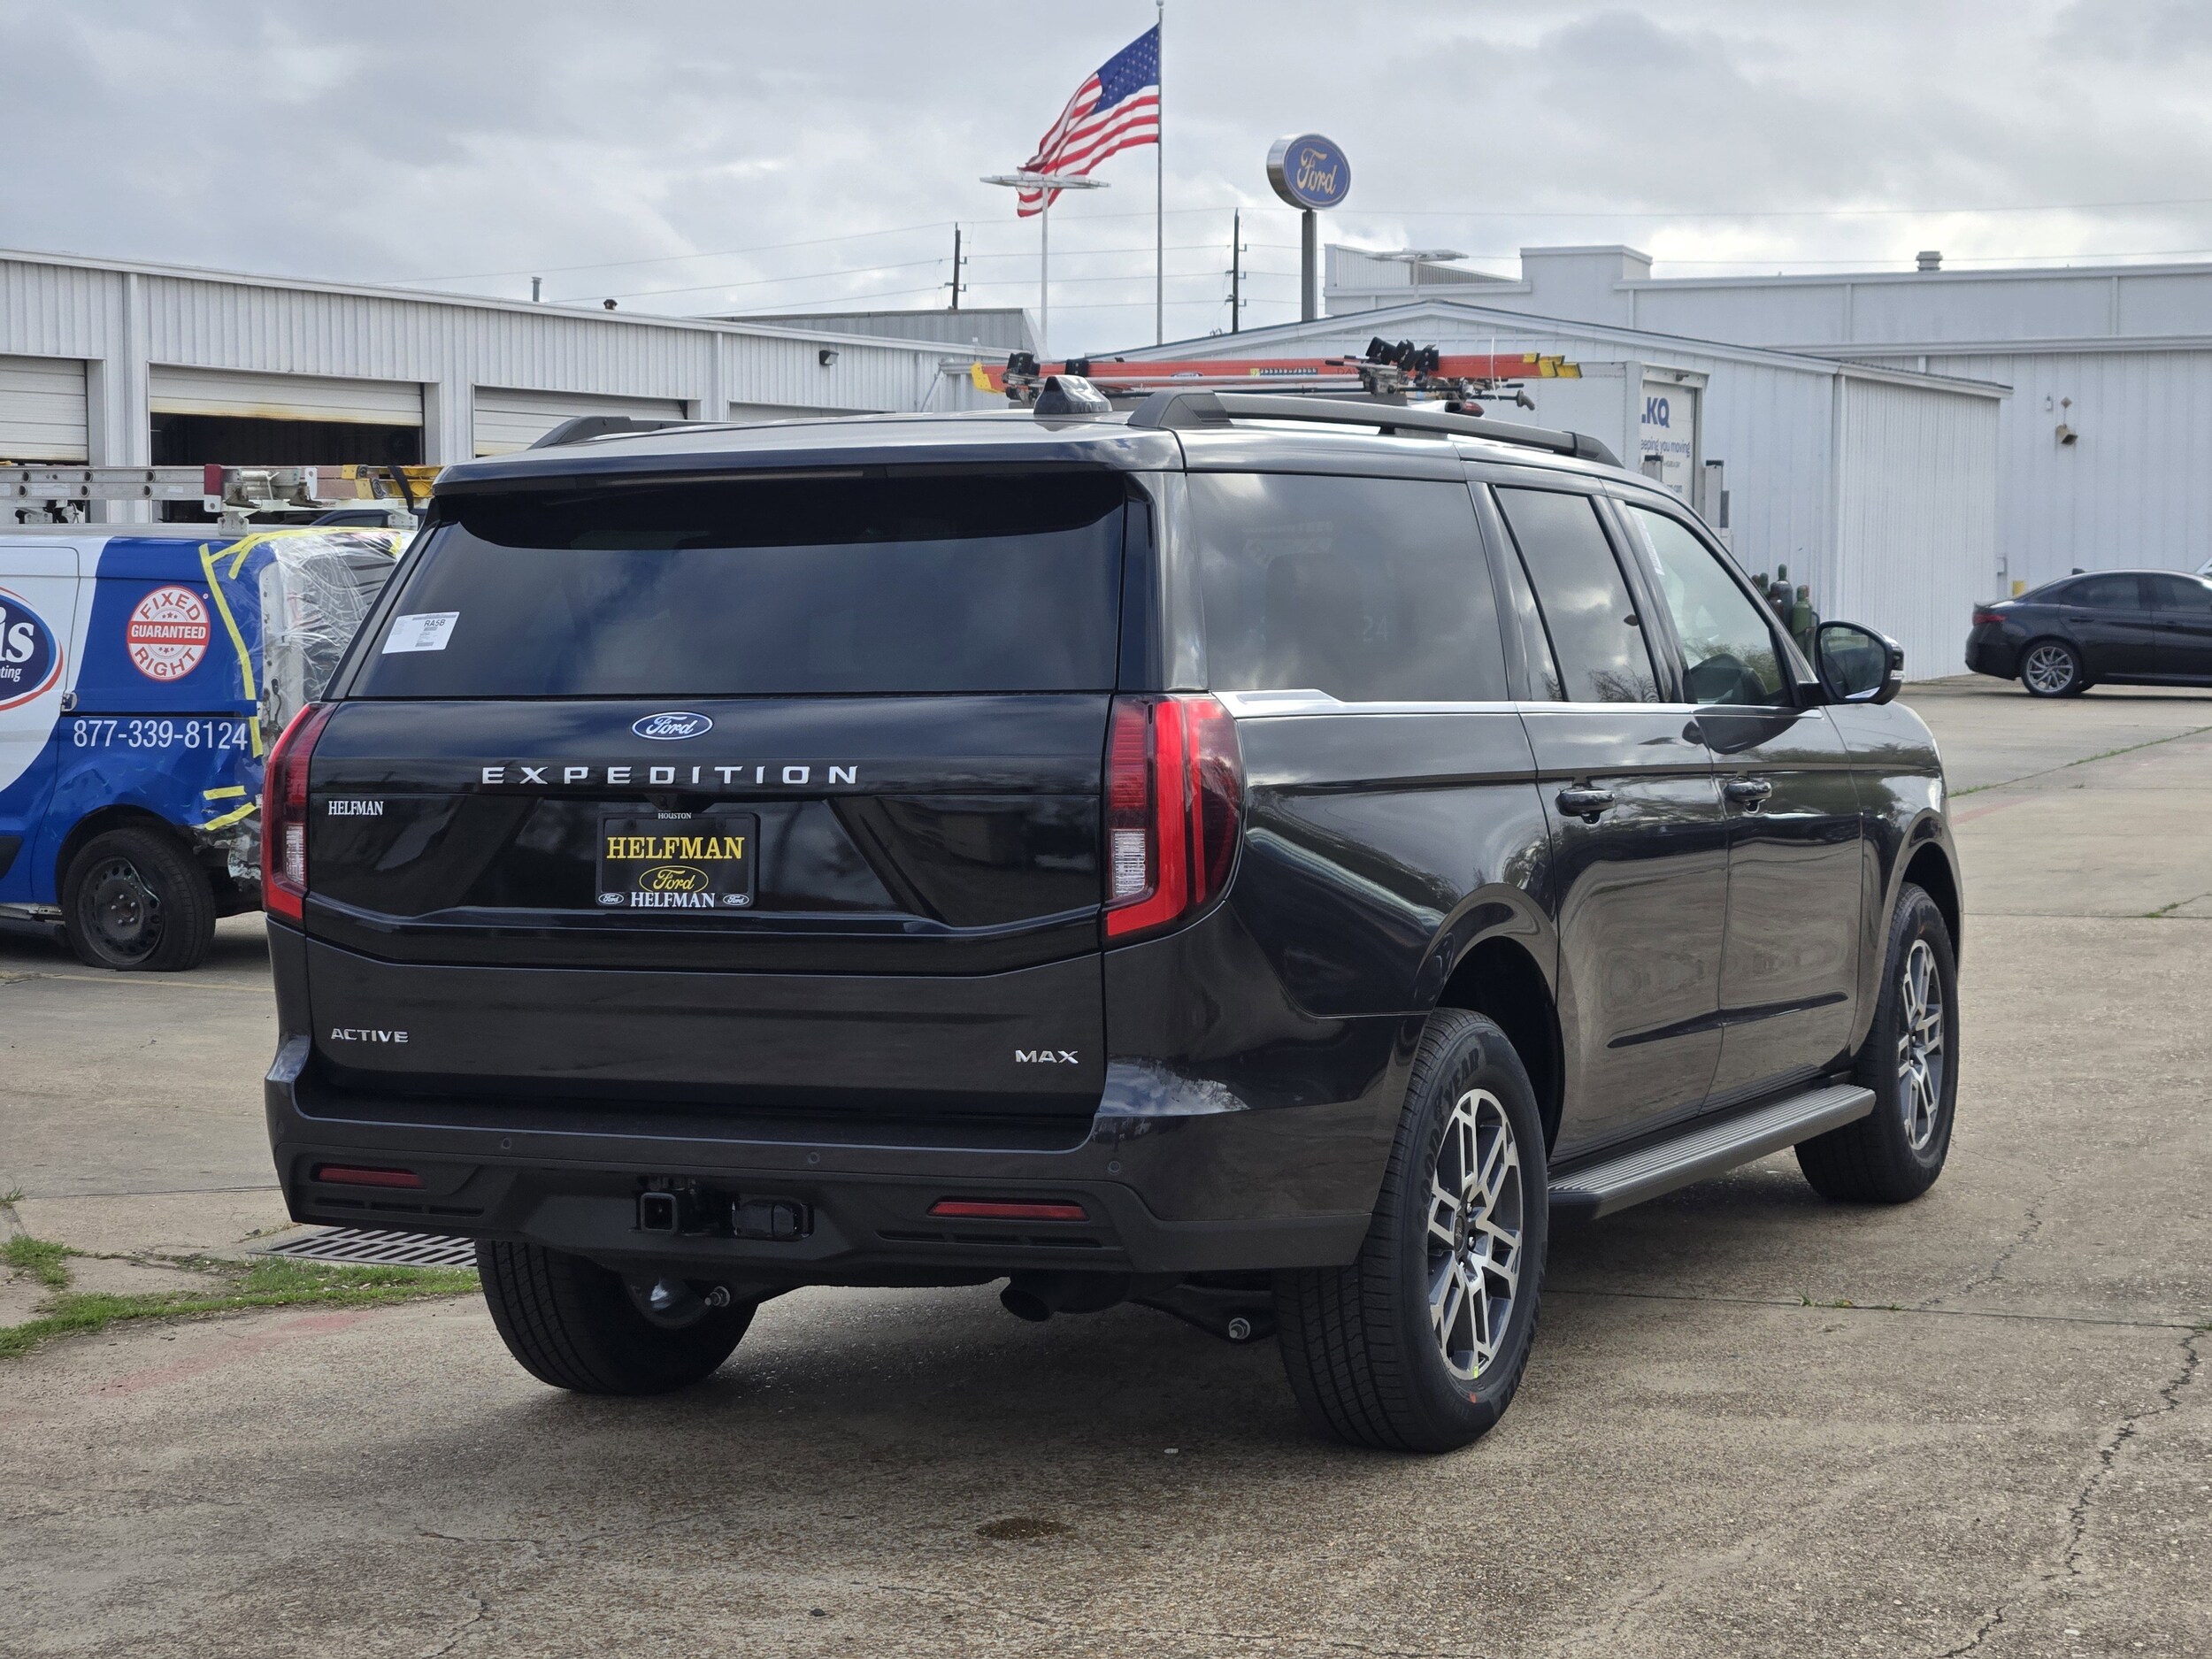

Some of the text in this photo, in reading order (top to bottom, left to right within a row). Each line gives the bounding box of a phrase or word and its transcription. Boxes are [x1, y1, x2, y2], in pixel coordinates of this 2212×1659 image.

[1297, 147, 1338, 195] Ford
[1641, 396, 1671, 428] KQ
[140, 592, 201, 621] FIXED
[131, 624, 207, 640] GUARANTEED
[134, 646, 196, 677] RIGHT
[0, 664, 22, 682] ting
[73, 719, 248, 751] 877-339-8124
[645, 716, 699, 735] Ford
[481, 765, 858, 785] EXPEDITION
[328, 800, 384, 816] HELFMAN
[606, 836, 745, 859] HELFMAN
[652, 869, 696, 890] Ford
[630, 892, 716, 909] HELFMAN
[331, 1028, 409, 1043] ACTIVE
[1015, 1049, 1079, 1064] MAX
